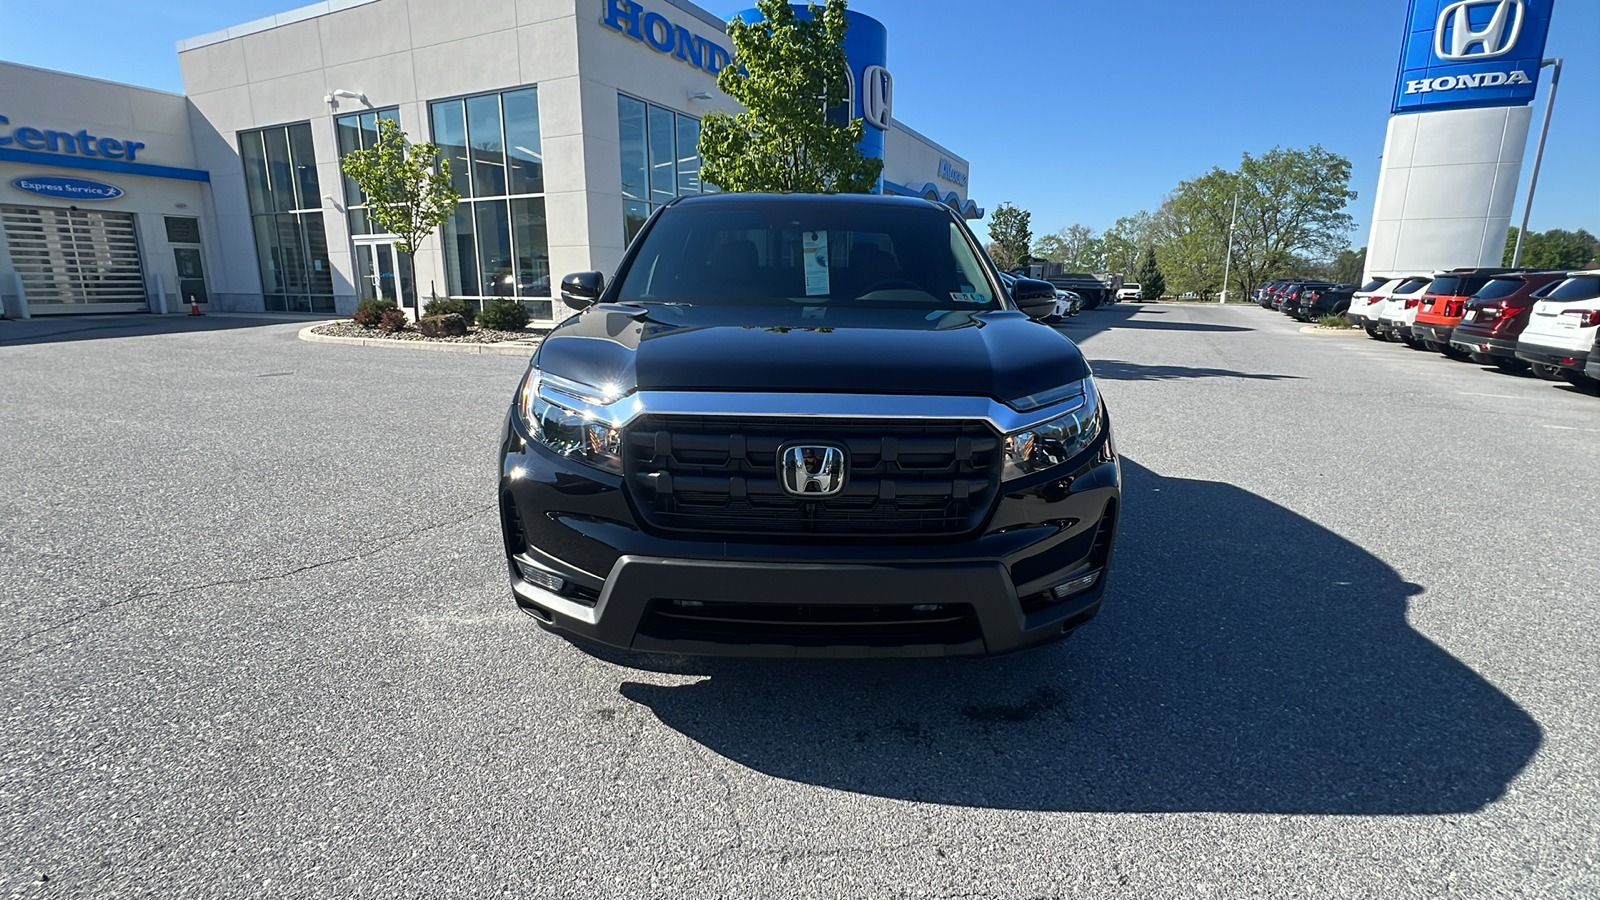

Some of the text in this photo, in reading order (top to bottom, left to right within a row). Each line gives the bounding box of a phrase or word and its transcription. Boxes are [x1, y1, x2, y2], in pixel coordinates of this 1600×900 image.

[603, 0, 750, 78] HOND
[1404, 70, 1532, 94] HONDA
[20, 180, 103, 195] Express Service
